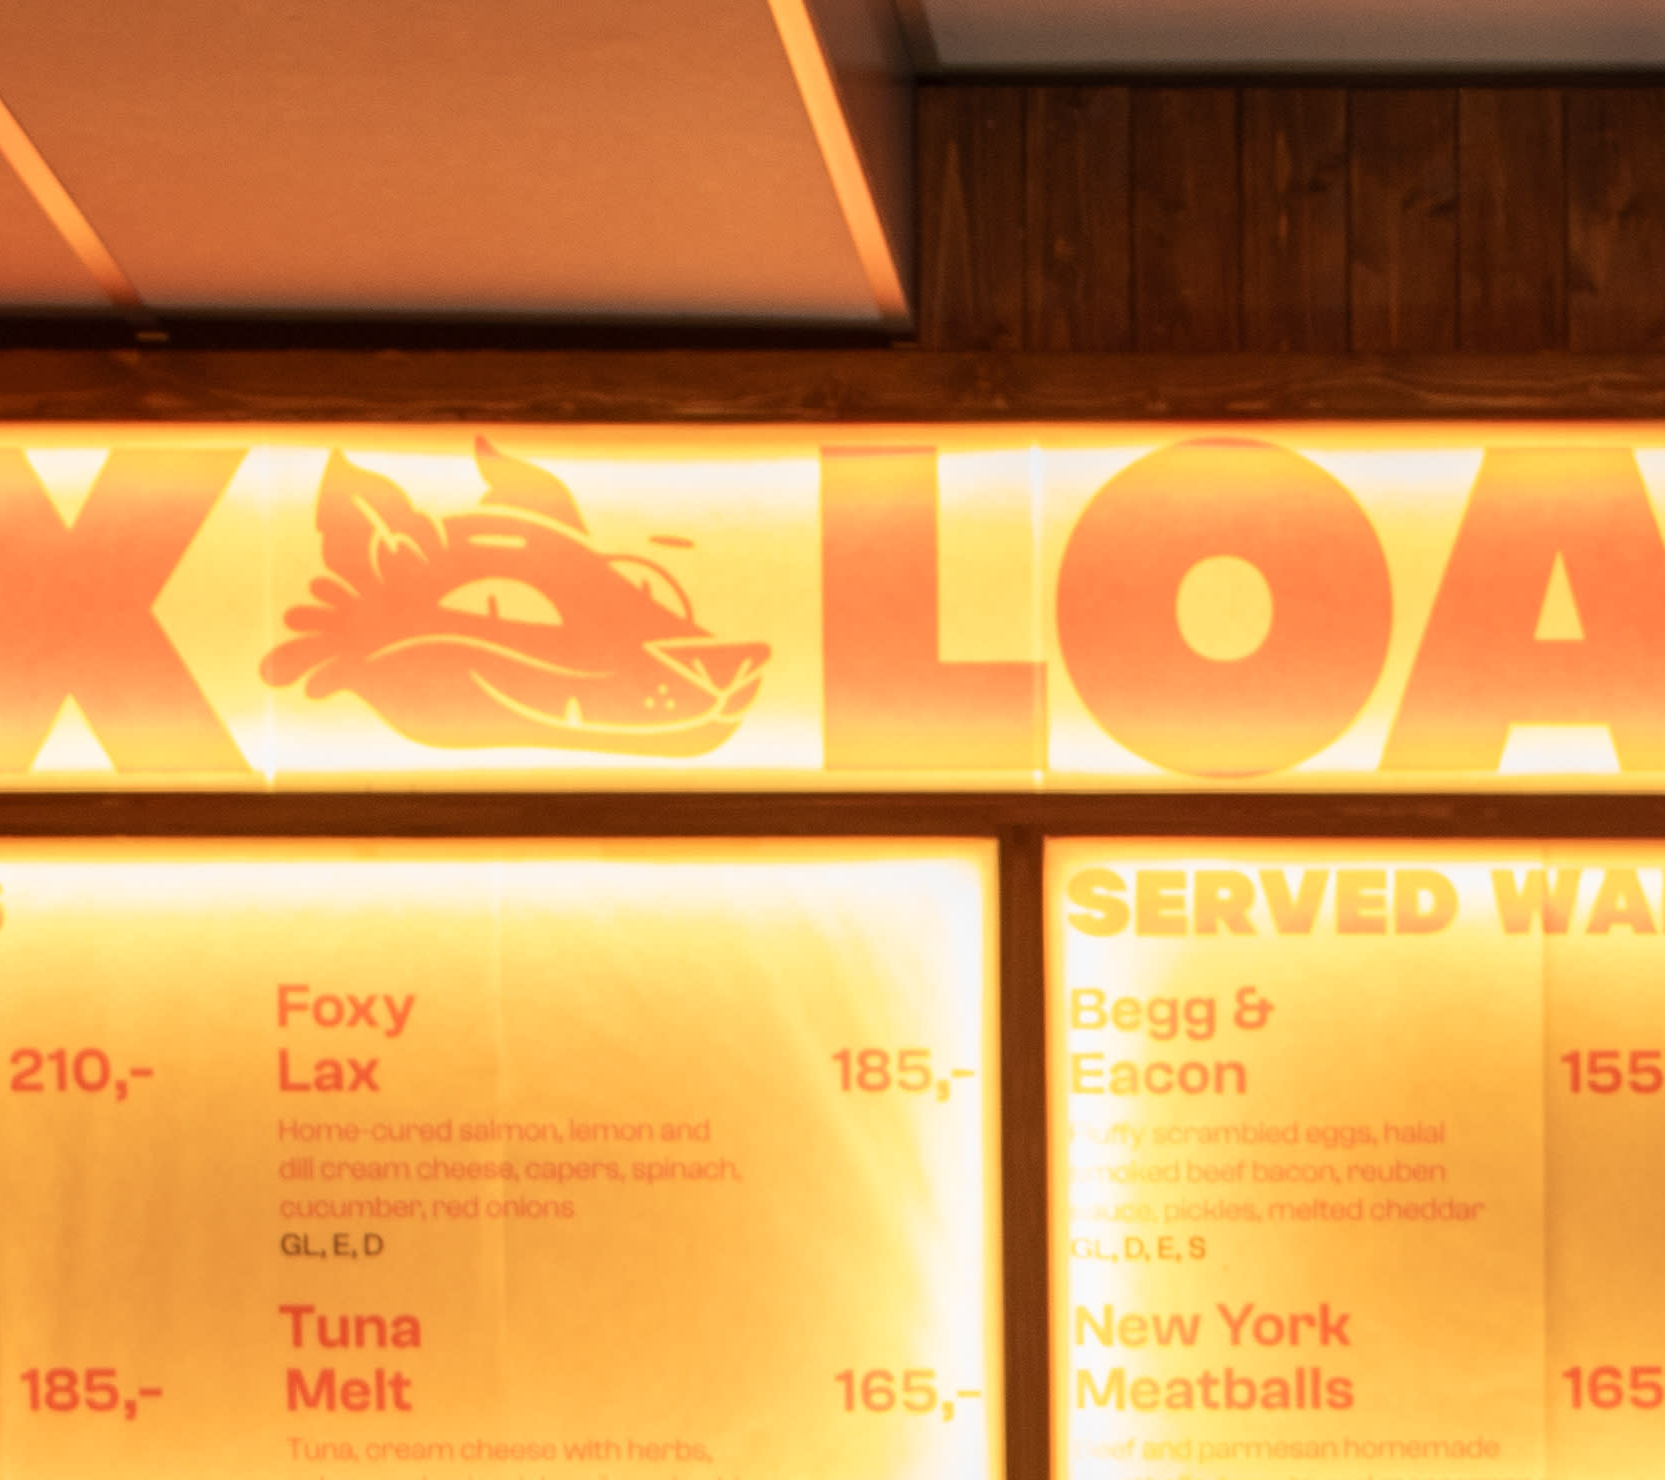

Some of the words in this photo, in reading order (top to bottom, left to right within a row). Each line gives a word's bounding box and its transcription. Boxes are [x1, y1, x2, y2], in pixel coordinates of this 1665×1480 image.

[1068, 869, 1459, 937] SERVED
[277, 984, 416, 1039] Foxy
[1071, 987, 1217, 1042] Begg
[1233, 985, 1275, 1031] &
[10, 1048, 154, 1102] 210,-
[278, 1048, 380, 1093] Lax
[831, 1048, 975, 1103] 185,-
[1072, 1051, 1247, 1096] Eacon
[278, 1304, 421, 1349] Tuna
[1076, 1303, 1202, 1348] New
[1216, 1302, 1351, 1347] York
[20, 1367, 163, 1421] 185,-
[286, 1367, 412, 1412] Melt
[835, 1369, 981, 1423] 165,-
[1077, 1366, 1355, 1411] Meatballs
